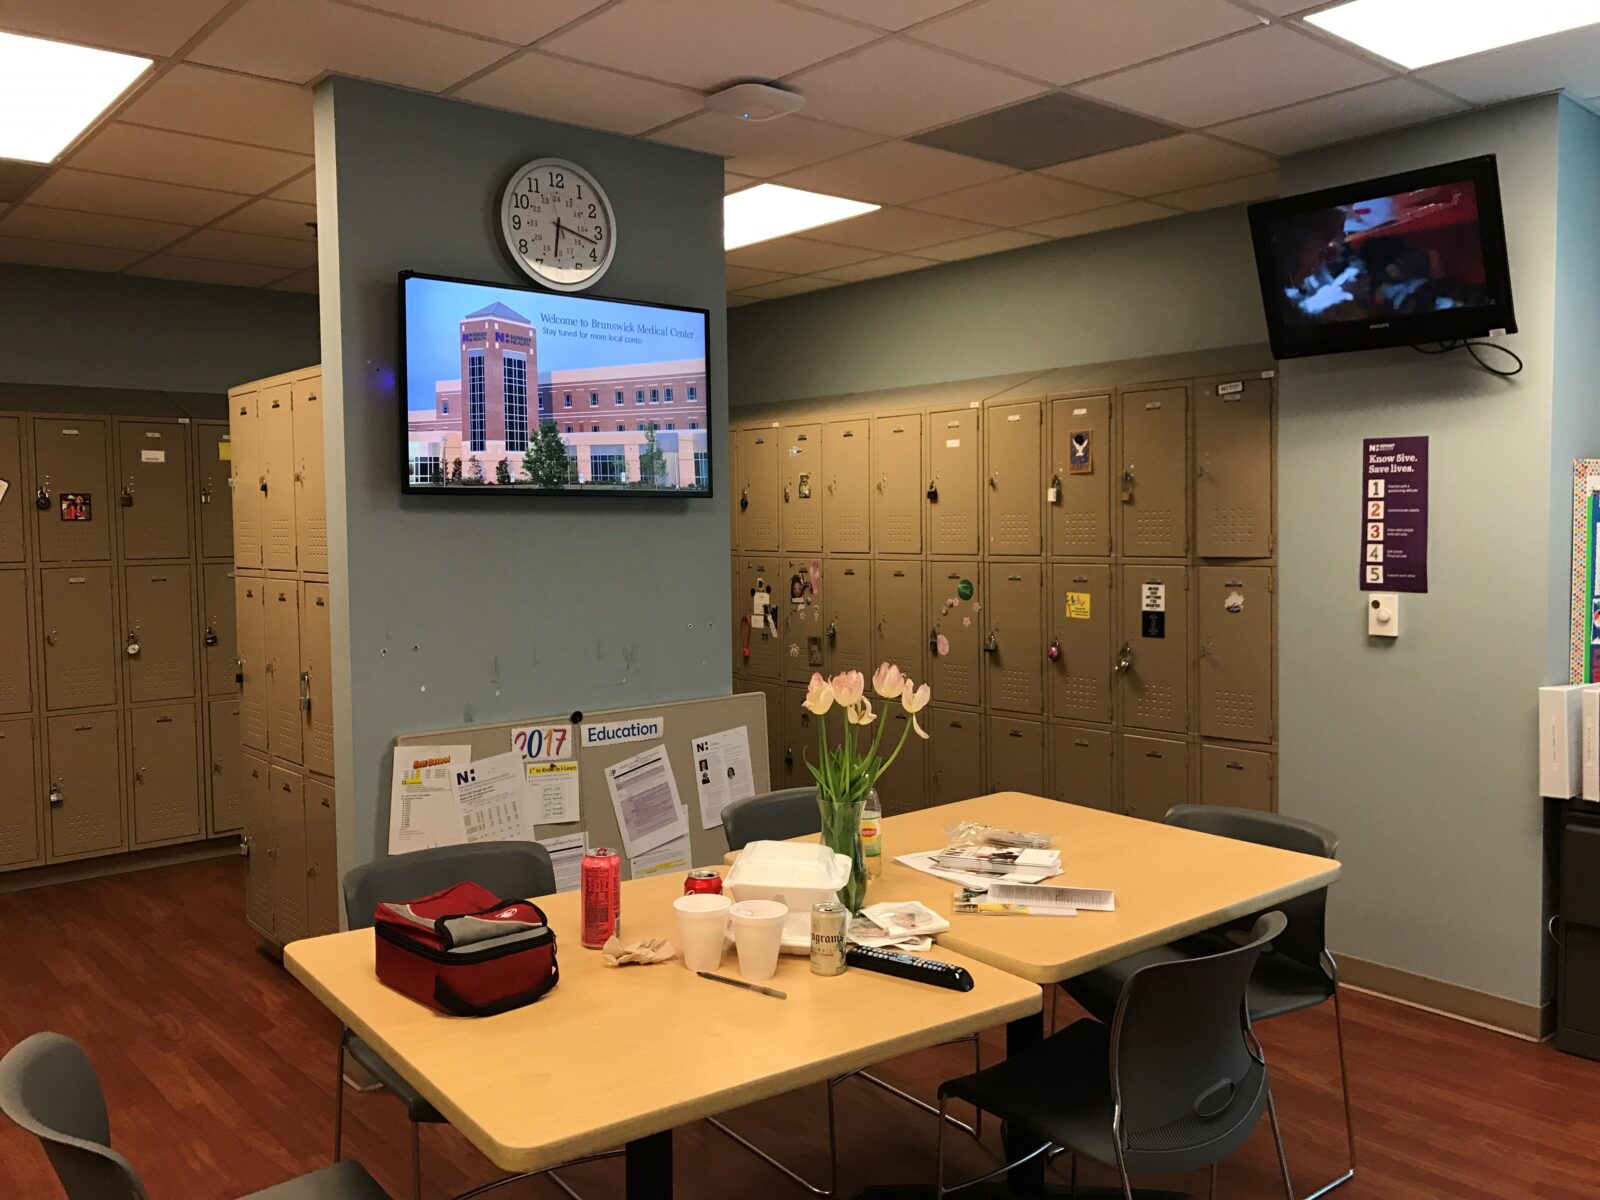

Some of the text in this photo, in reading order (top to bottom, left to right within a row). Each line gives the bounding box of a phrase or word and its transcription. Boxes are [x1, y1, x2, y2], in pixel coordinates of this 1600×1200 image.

[528, 178, 540, 193] 11
[548, 172, 564, 188] 12
[576, 185, 582, 200] 1
[514, 193, 529, 209] 10
[588, 204, 596, 219] 2
[512, 215, 521, 230] 9
[594, 226, 602, 240] 3
[519, 239, 528, 254] 8
[590, 248, 598, 262] 4
[540, 312, 694, 339] Welcome to Brunswick Medical Center
[542, 326, 556, 336] Stay
[558, 329, 578, 337] tuned
[579, 330, 588, 338] for
[609, 334, 622, 342] local
[1369, 454, 1395, 463] Know
[1369, 464, 1414, 473] Save lives.
[1373, 482, 1379, 496] 1
[1371, 503, 1380, 516] 2
[1370, 525, 1380, 538] 3
[1370, 546, 1378, 560] 4
[1370, 568, 1379, 581] 5
[588, 722, 658, 742] Education
[514, 728, 566, 759] 2017
